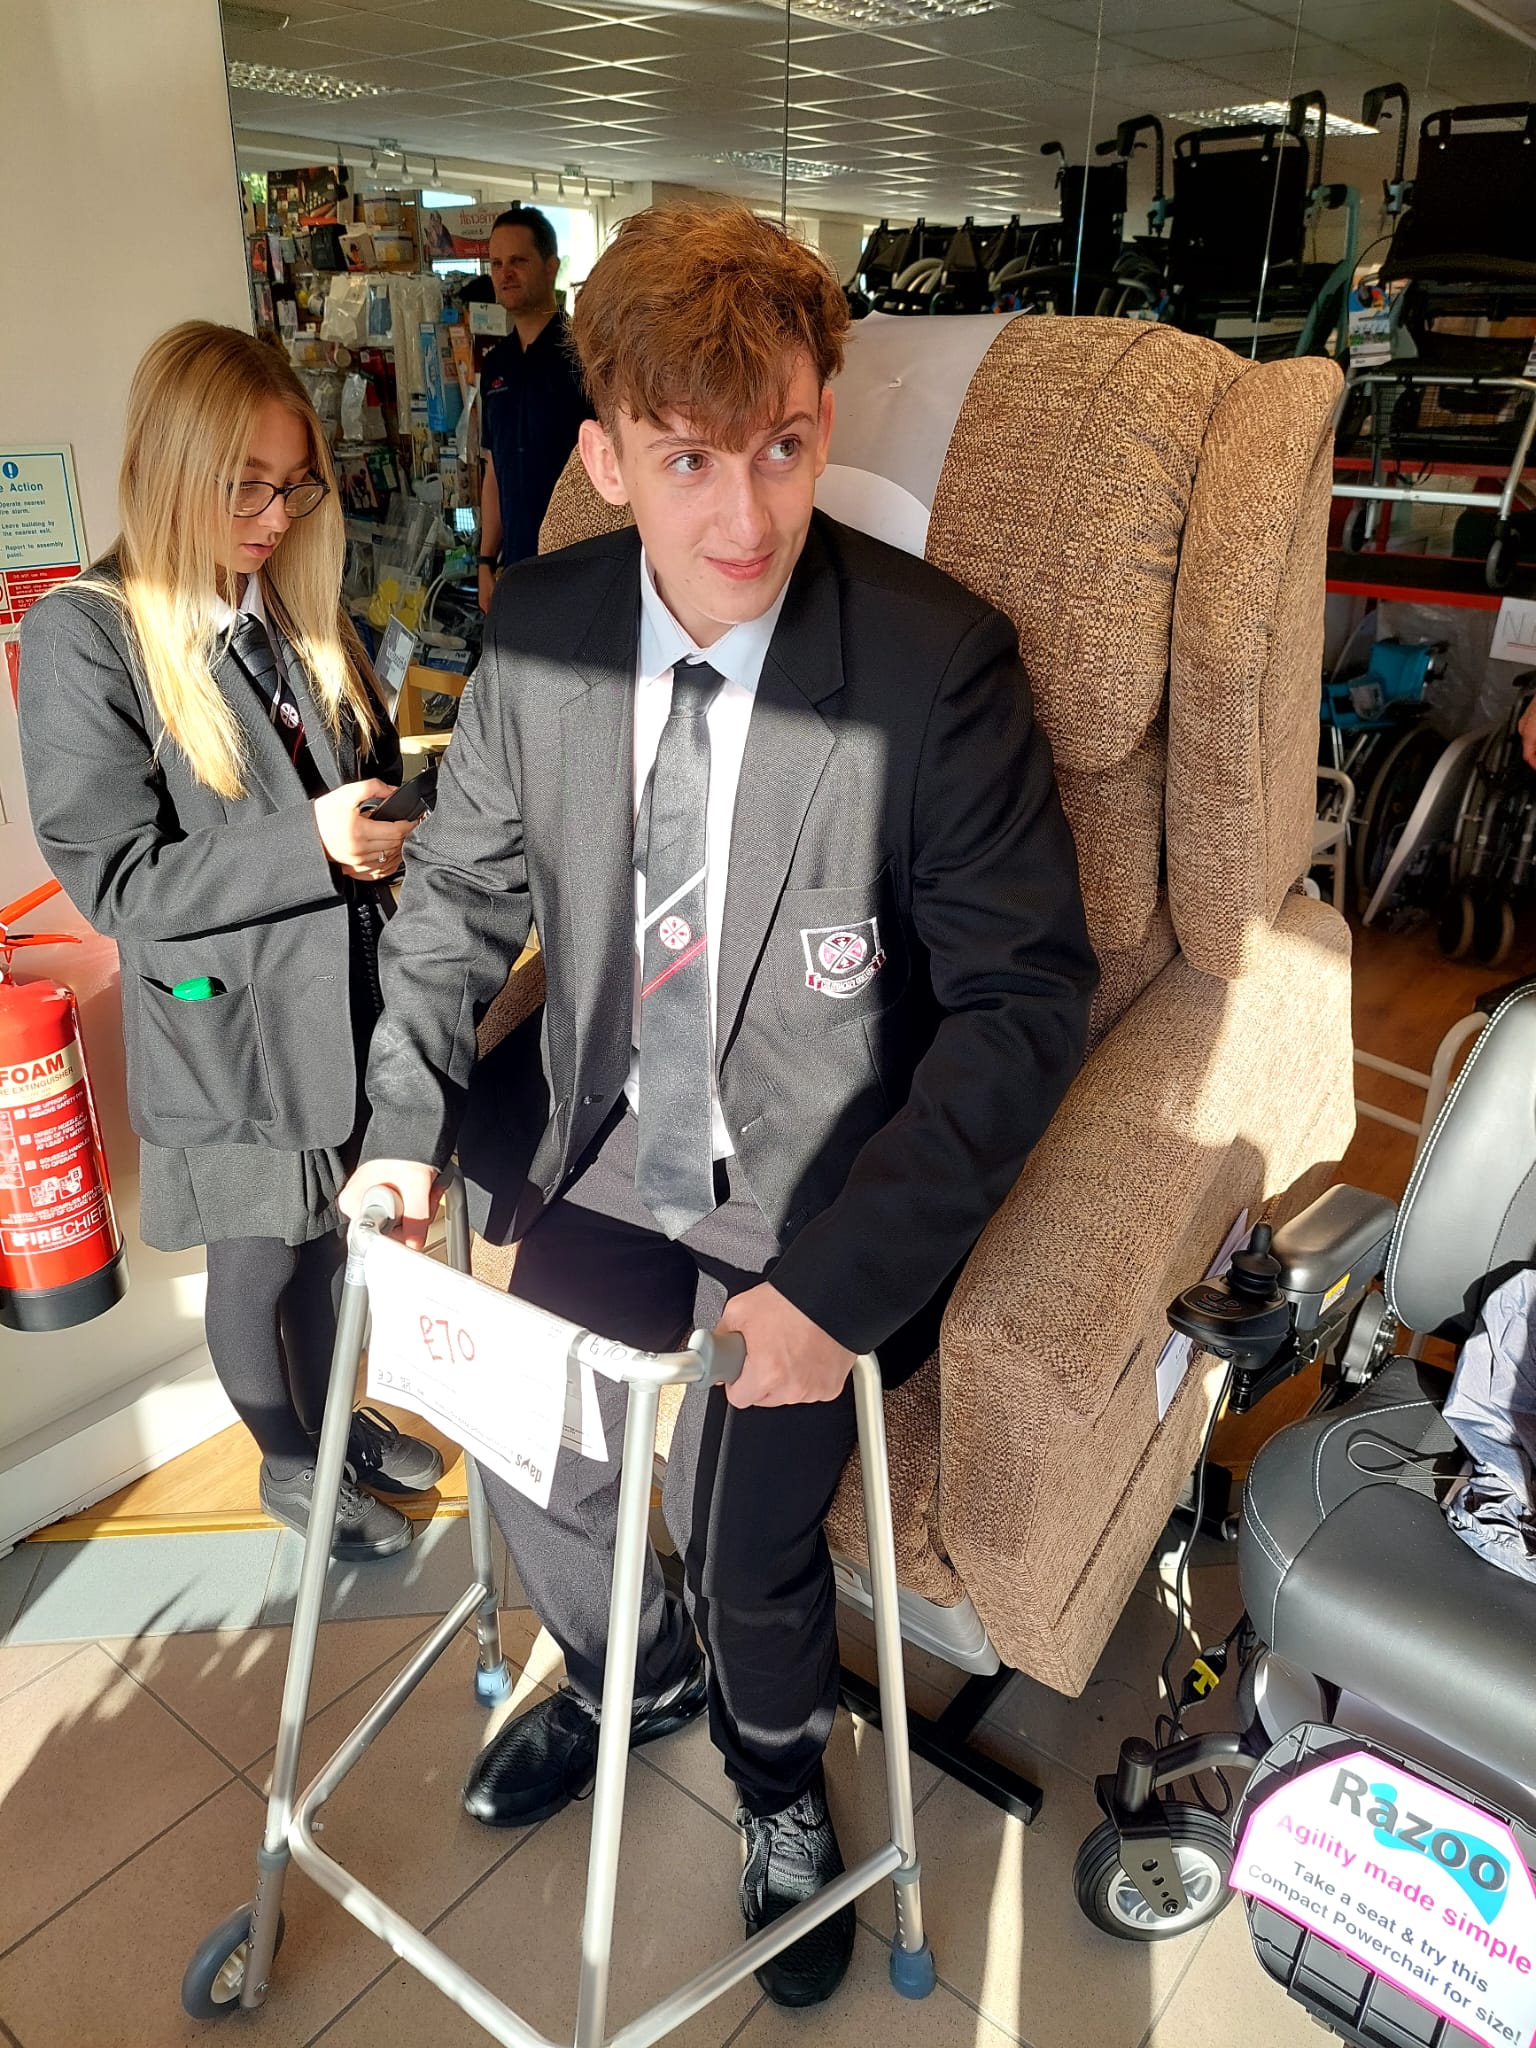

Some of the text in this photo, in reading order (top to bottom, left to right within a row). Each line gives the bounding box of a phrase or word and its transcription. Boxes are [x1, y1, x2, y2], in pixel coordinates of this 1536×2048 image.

[10, 482, 44, 492] Action
[21, 520, 46, 529] building
[5, 544, 26, 552] Report
[0, 1053, 65, 1087] FOAM
[12, 1066, 74, 1094] EXTINGUISHER
[73, 1169, 80, 1179] B
[18, 1202, 105, 1246] FIRECHIEF
[420, 1315, 475, 1364] £70
[1328, 1767, 1508, 1893] Razoo
[1276, 1814, 1533, 1976] Agility made simple
[1293, 1861, 1489, 1994] Take a seat & try this
[1247, 1864, 1523, 2047] Compact Powerchair for size!
